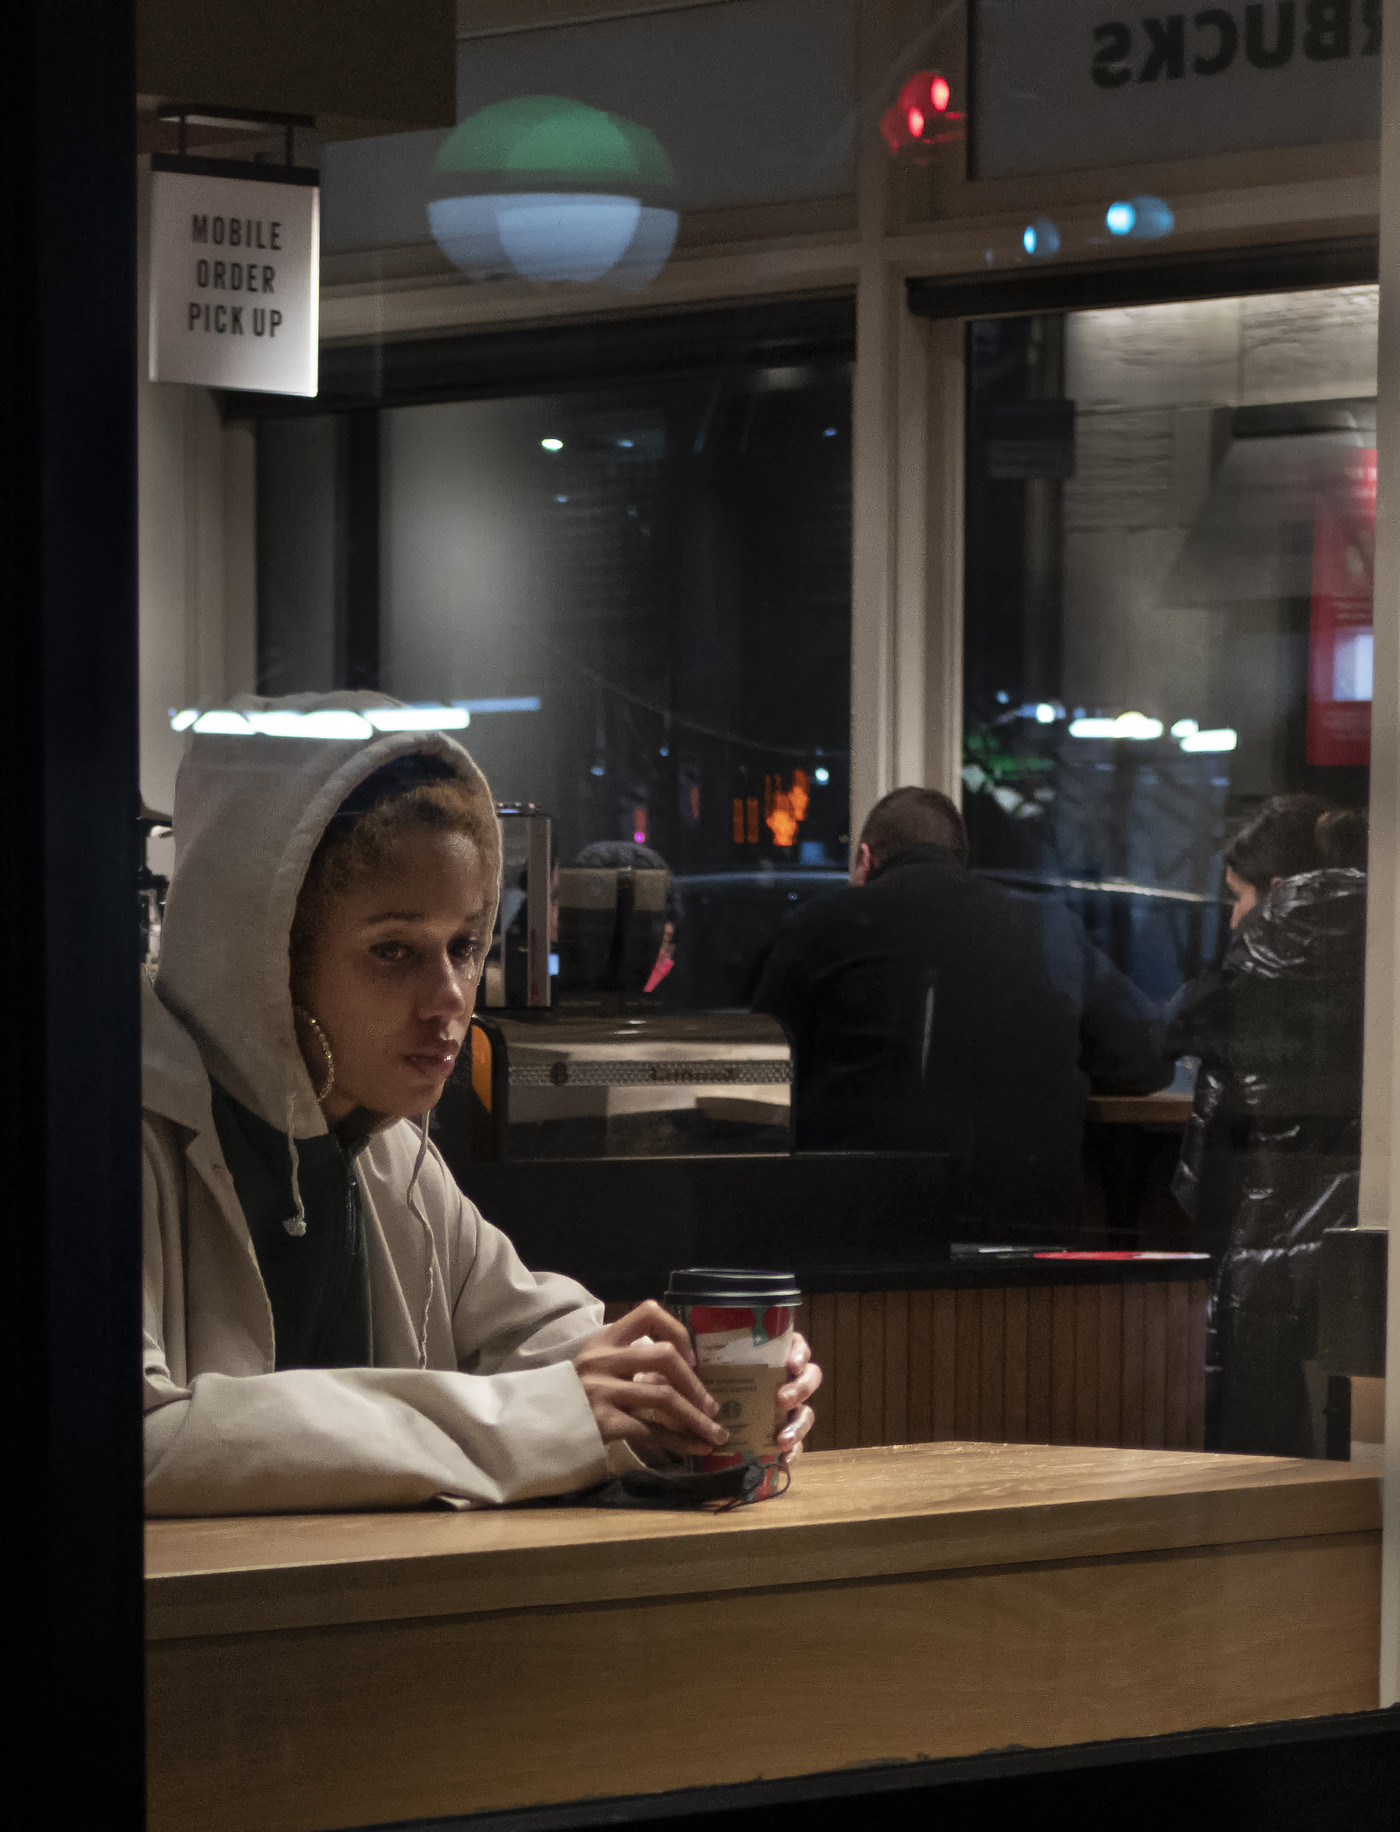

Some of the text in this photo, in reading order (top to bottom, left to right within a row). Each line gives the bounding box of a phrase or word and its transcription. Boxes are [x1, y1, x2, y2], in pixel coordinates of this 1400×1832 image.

[192, 214, 282, 250] MOBILE
[197, 259, 275, 293] ORDER
[188, 302, 283, 338] PICK UP
